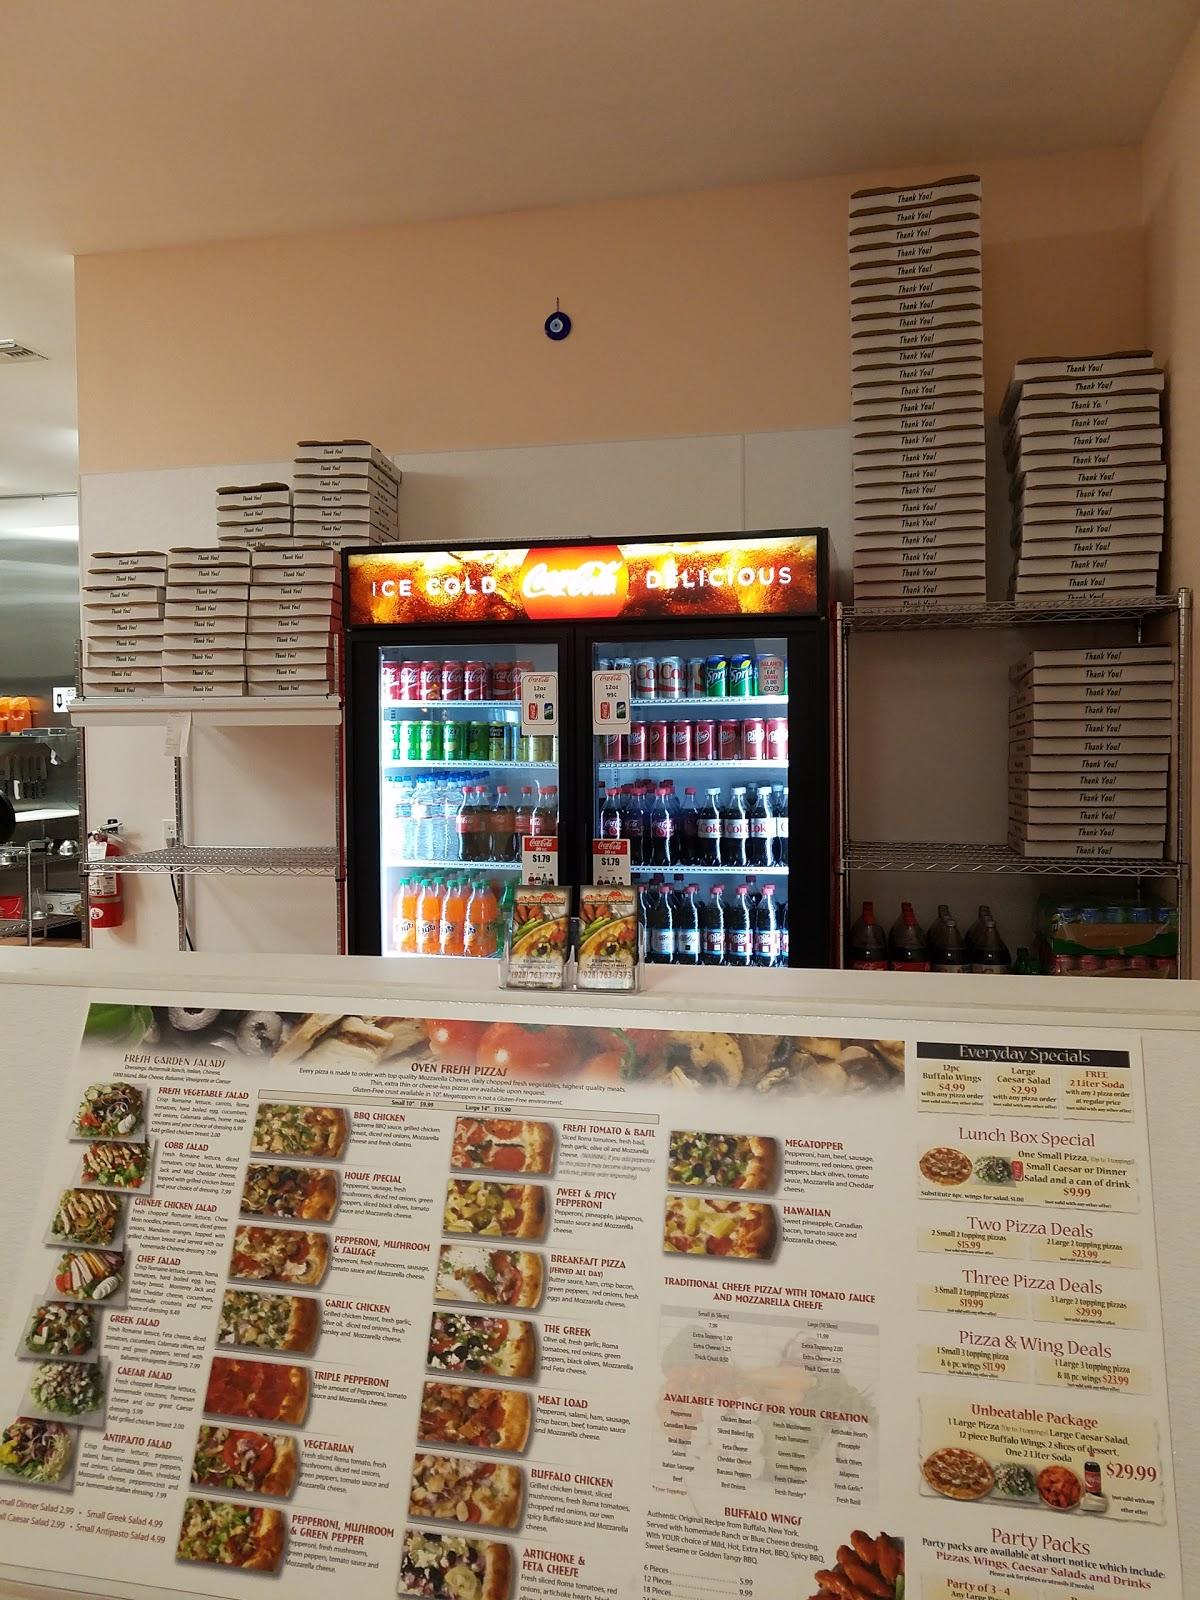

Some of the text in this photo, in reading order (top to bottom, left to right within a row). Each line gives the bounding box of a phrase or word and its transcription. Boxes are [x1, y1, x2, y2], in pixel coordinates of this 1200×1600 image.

[898, 192, 932, 203] Thank You!
[900, 333, 934, 344] Thank You!
[1066, 364, 1103, 373] Thank You!
[1071, 417, 1108, 427] Thank You!
[1076, 489, 1113, 498] Thank You!
[371, 580, 411, 597] ICE
[426, 576, 497, 595] COLD
[646, 567, 793, 589] DELICIOUS
[1085, 651, 1121, 660] Thank You!
[1076, 846, 1112, 855] Thank You!
[602, 858, 619, 866] $1.79
[124, 1054, 226, 1069] FRESH GARDEN SALADS
[959, 1045, 1091, 1065] Everyday Specials
[411, 1062, 508, 1078] OVEN FRESH PIZZAS
[943, 1064, 960, 1073] 12pc
[1011, 1067, 1036, 1076] Large
[1085, 1070, 1108, 1078] FREE
[922, 1072, 982, 1083] Buffalo Wings
[997, 1075, 1051, 1085] Caesar Salad
[939, 1083, 965, 1092] $4.99
[1011, 1085, 1037, 1095] $2.99
[1077, 1080, 1099, 1088] Liter
[1101, 1081, 1125, 1089] Soda
[159, 1087, 249, 1100] FRESH VEGETABLE SALAD
[465, 1104, 479, 1112] Large
[353, 1111, 406, 1122] BBQ CHICKEN
[562, 1123, 656, 1138] FRESH TOMATO & BASIL
[959, 1127, 1095, 1148] Lunch Box Special
[164, 1141, 209, 1151] COBB SALAD
[785, 1139, 844, 1151] MEGATOPPER
[1018, 1151, 1035, 1159] One
[1037, 1151, 1061, 1160] Small
[557, 1188, 617, 1201] SWEET & SPICY
[1064, 1188, 1091, 1198] $9.99
[135, 1198, 217, 1213] CHINESE CHICKEN SALAD
[556, 1198, 602, 1210] PEPPERONI
[783, 1206, 831, 1218] HAWAIIAN
[967, 1216, 1093, 1238] Two Pizza Deals
[957, 1240, 981, 1250] $15.99
[551, 1254, 626, 1269] BREAKFAST PIZZA
[1072, 1250, 1098, 1260] $23.99
[664, 1276, 876, 1304] TRADITIONAL CHEESE PIZZAS WITH TOMATO SAUCE
[325, 1298, 391, 1313] GARLIC CHICKEN
[713, 1292, 824, 1311] AND MOZZARELLA CHEESE
[110, 1314, 160, 1328] GREEK SALAD
[544, 1322, 591, 1337] THE GREEK
[960, 1330, 1112, 1358] Pizza & Wing Deals
[314, 1371, 389, 1388] TRIPLE PEPPERONI
[1102, 1375, 1129, 1386] $23.99
[538, 1394, 588, 1410] MEAT LOAD
[664, 1392, 869, 1424] AVAILABLE TOPPINGS FOR YOUR CREATION
[971, 1403, 1098, 1430] Unbeatable Package
[303, 1439, 354, 1454] VEGETARIAN
[531, 1468, 613, 1488] BUFFALO CHICKEN
[1106, 1462, 1157, 1483] $29.99
[17, 1501, 74, 1515] Dinner Salad 2.99
[86, 1509, 163, 1528] Small Greek Salad 4.99
[724, 1506, 802, 1526] BUFFALO WINGS
[991, 1528, 1090, 1555] Party Packs
[523, 1548, 586, 1566] ARTICHOKE &
[522, 1560, 579, 1579] FETA CHEESE
[1012, 1561, 1049, 1574] Caesar
[1051, 1566, 1086, 1580] Salads
[1088, 1571, 1111, 1584] and
[1113, 1574, 1152, 1589] Drinks
